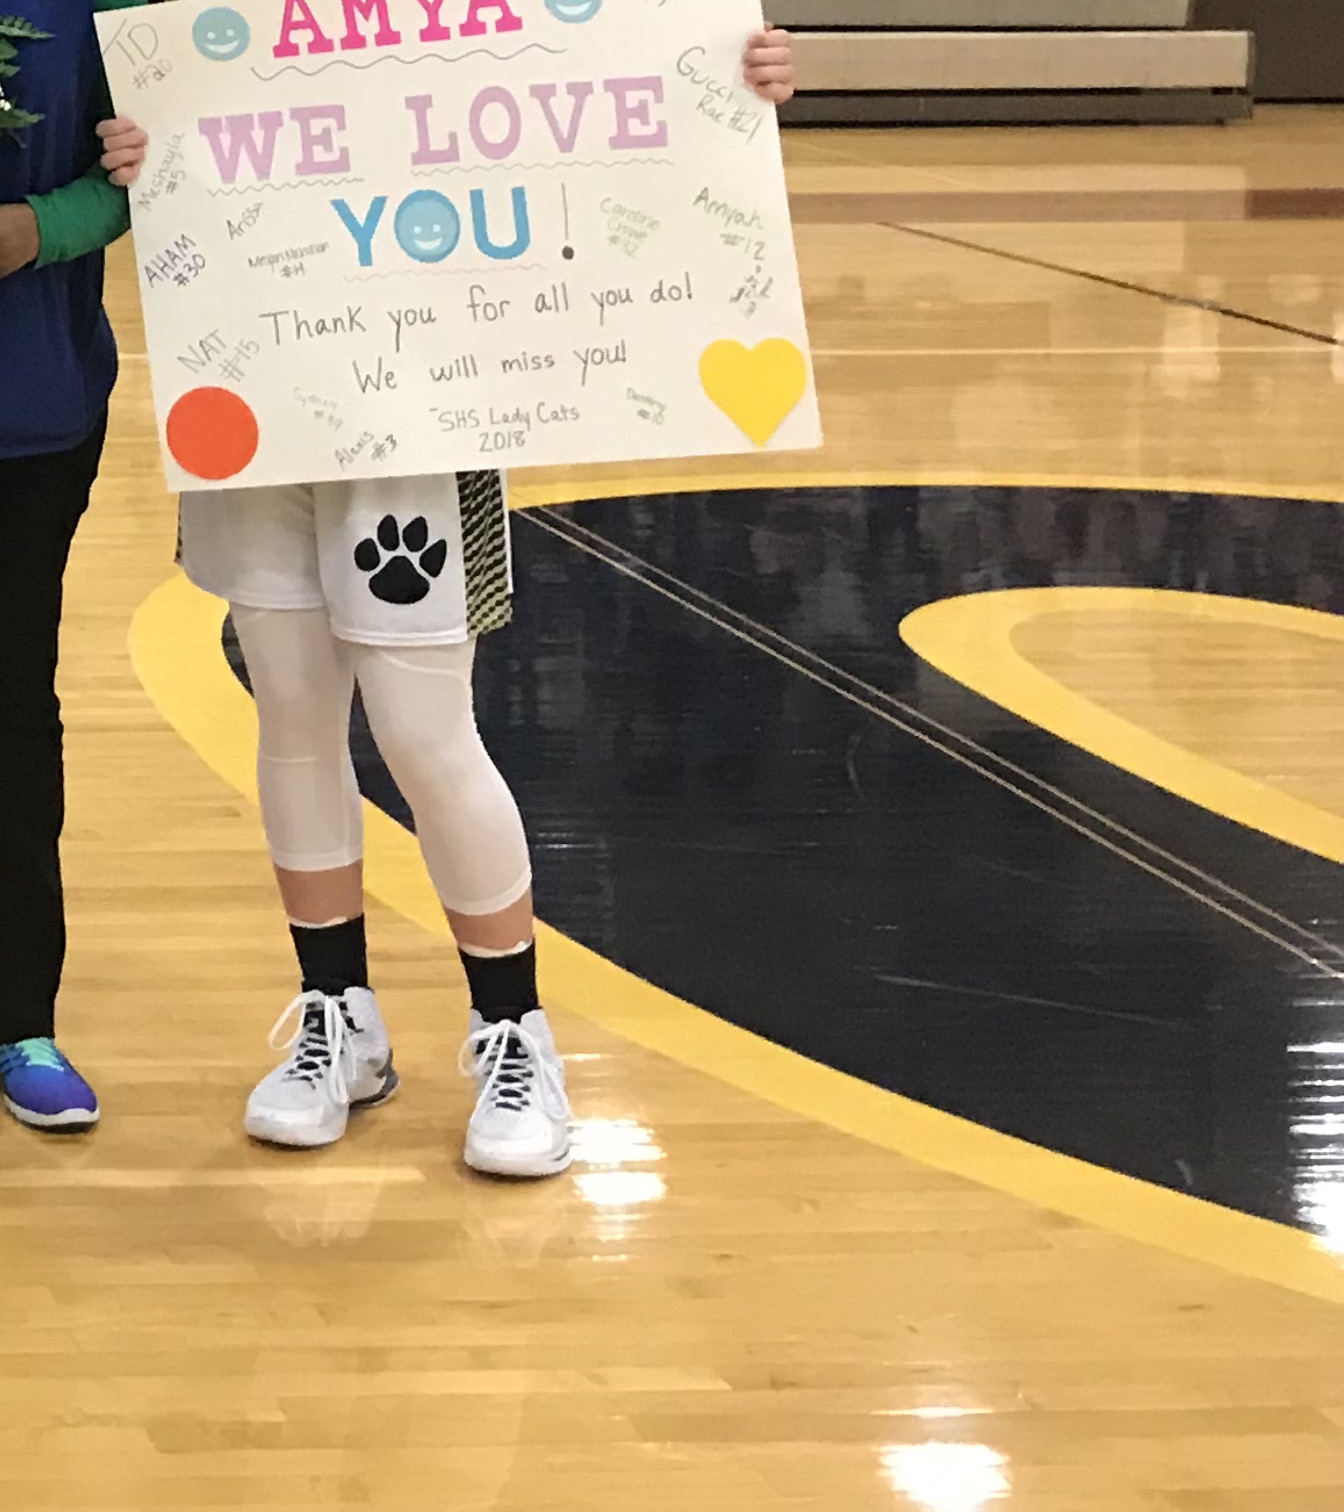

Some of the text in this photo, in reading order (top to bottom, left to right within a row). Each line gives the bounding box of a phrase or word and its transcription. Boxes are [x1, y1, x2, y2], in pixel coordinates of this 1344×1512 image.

[197, 75, 669, 185] WE LOVE
[165, 168, 187, 195] #5
[172, 253, 207, 288] #30
[257, 305, 367, 346] Thank
[386, 305, 438, 354] you
[465, 283, 511, 323] for
[534, 281, 570, 313] all
[590, 285, 635, 327] you
[649, 270, 694, 304] do!
[175, 327, 229, 375] NAT
[351, 338, 628, 395] We will miss you!
[488, 405, 532, 432] Lady
[535, 400, 581, 425] Cats
[369, 433, 399, 462] #3
[478, 429, 527, 454] 2018
